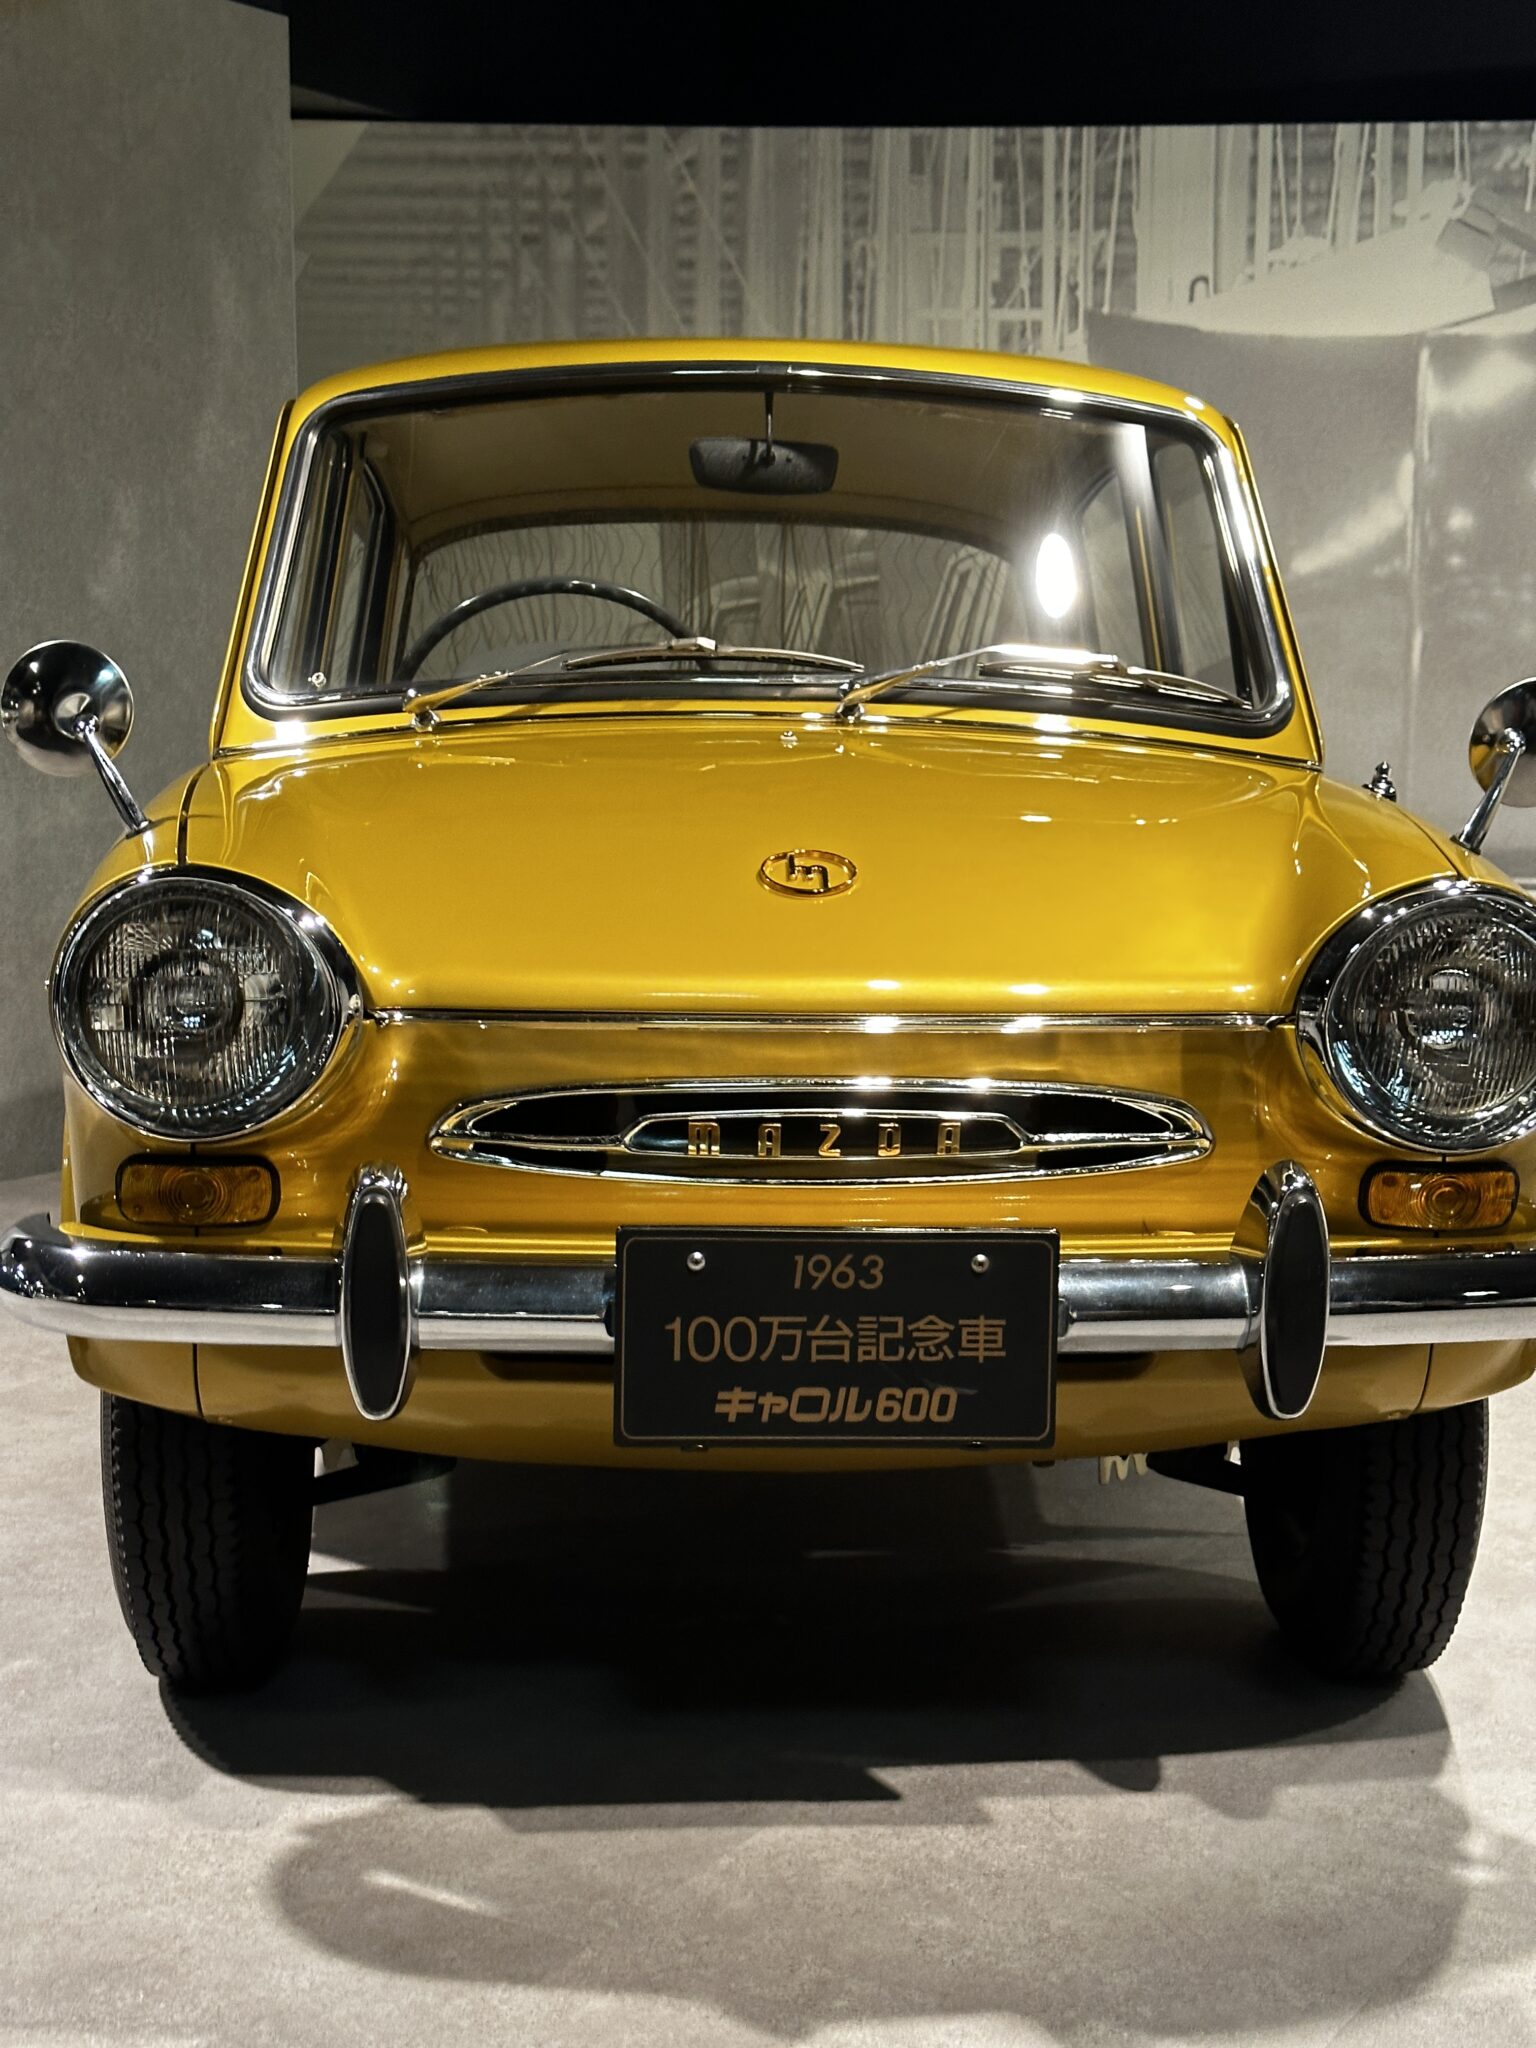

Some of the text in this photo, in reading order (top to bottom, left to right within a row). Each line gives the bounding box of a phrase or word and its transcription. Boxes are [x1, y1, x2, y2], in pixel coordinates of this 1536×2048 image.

[687, 1121, 962, 1157] MAZDA
[793, 1253, 885, 1290] 1963
[664, 1313, 1007, 1364] 100万台記念車
[714, 1385, 959, 1424] キャロル600
